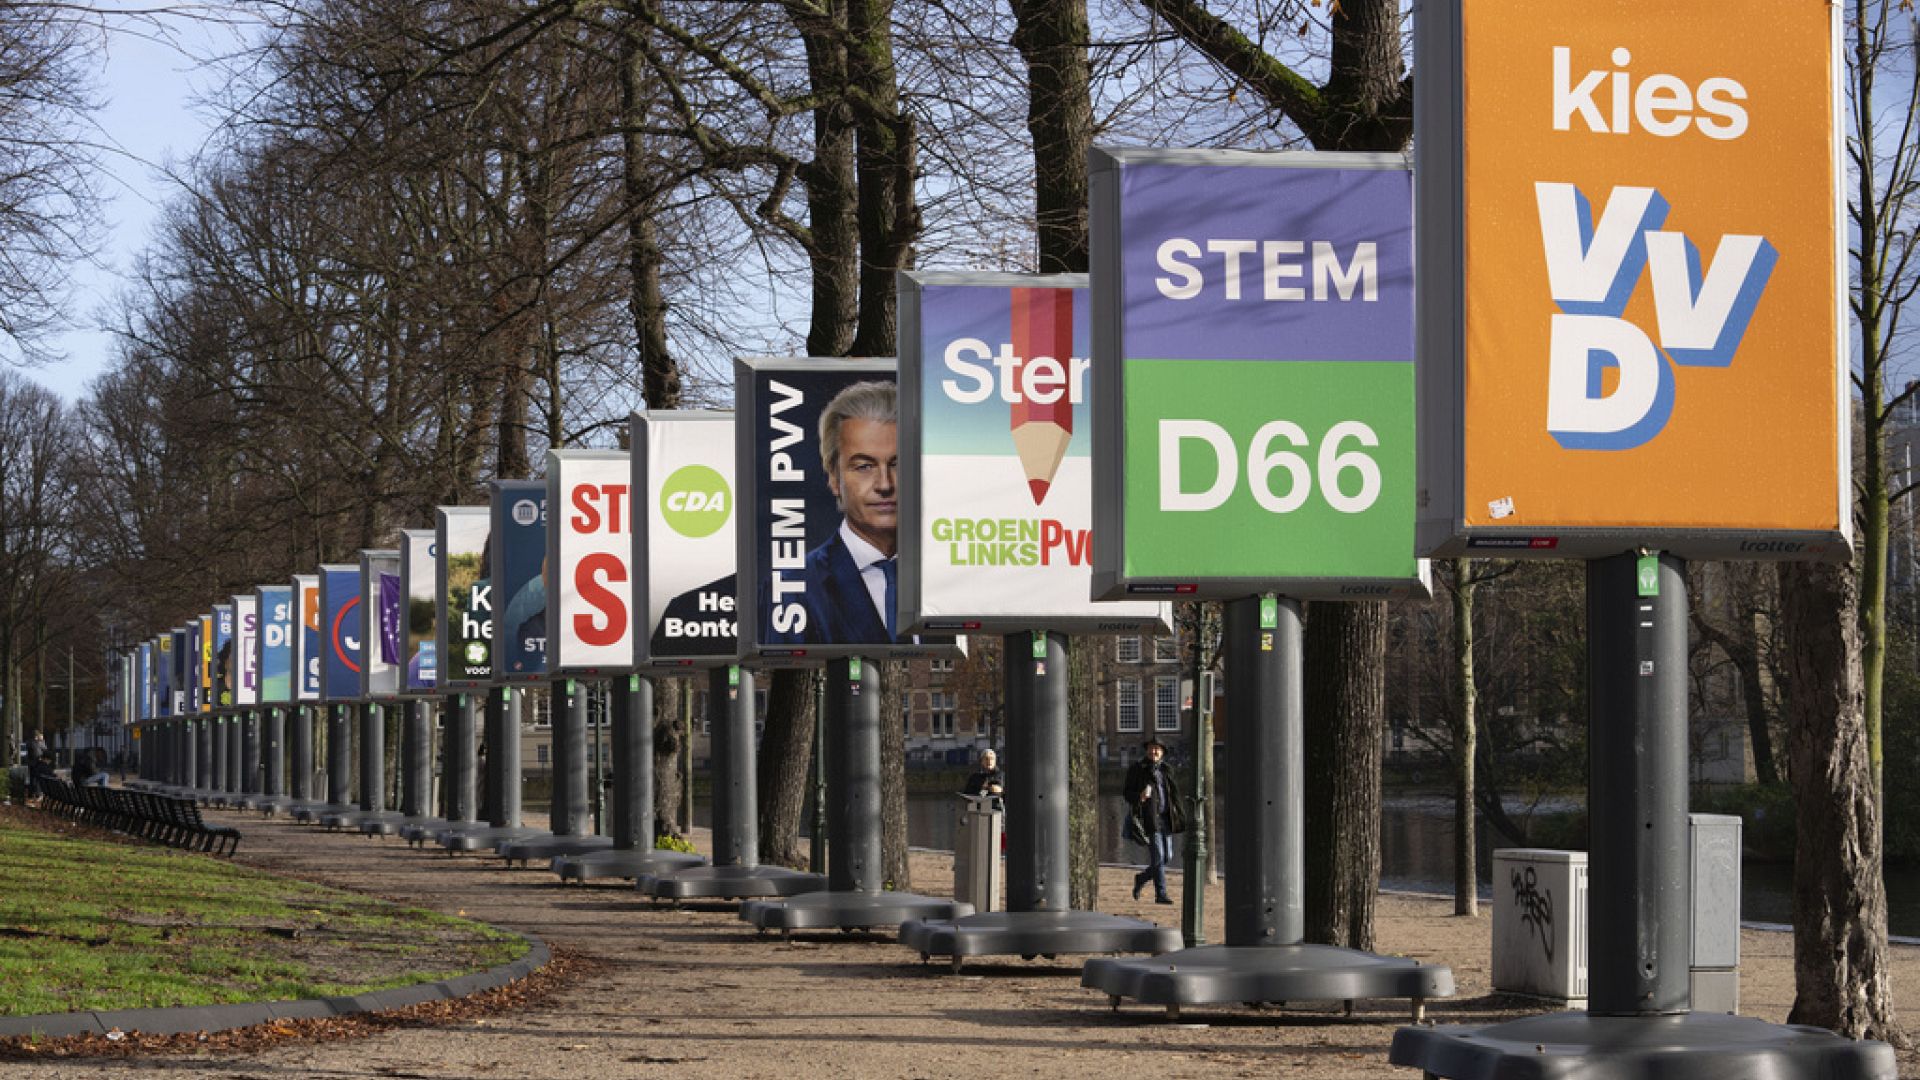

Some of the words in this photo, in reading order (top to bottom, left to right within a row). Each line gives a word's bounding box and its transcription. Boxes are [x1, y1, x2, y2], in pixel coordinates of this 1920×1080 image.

[1552, 45, 1749, 140] kies
[1155, 238, 1379, 302] STEM
[769, 379, 805, 482] PVV
[1158, 418, 1382, 514] D66
[571, 483, 632, 534] ST
[666, 491, 725, 512] CDA
[931, 518, 1039, 542] GROEN
[770, 499, 808, 634] STEM
[950, 542, 1039, 566] LINKS
